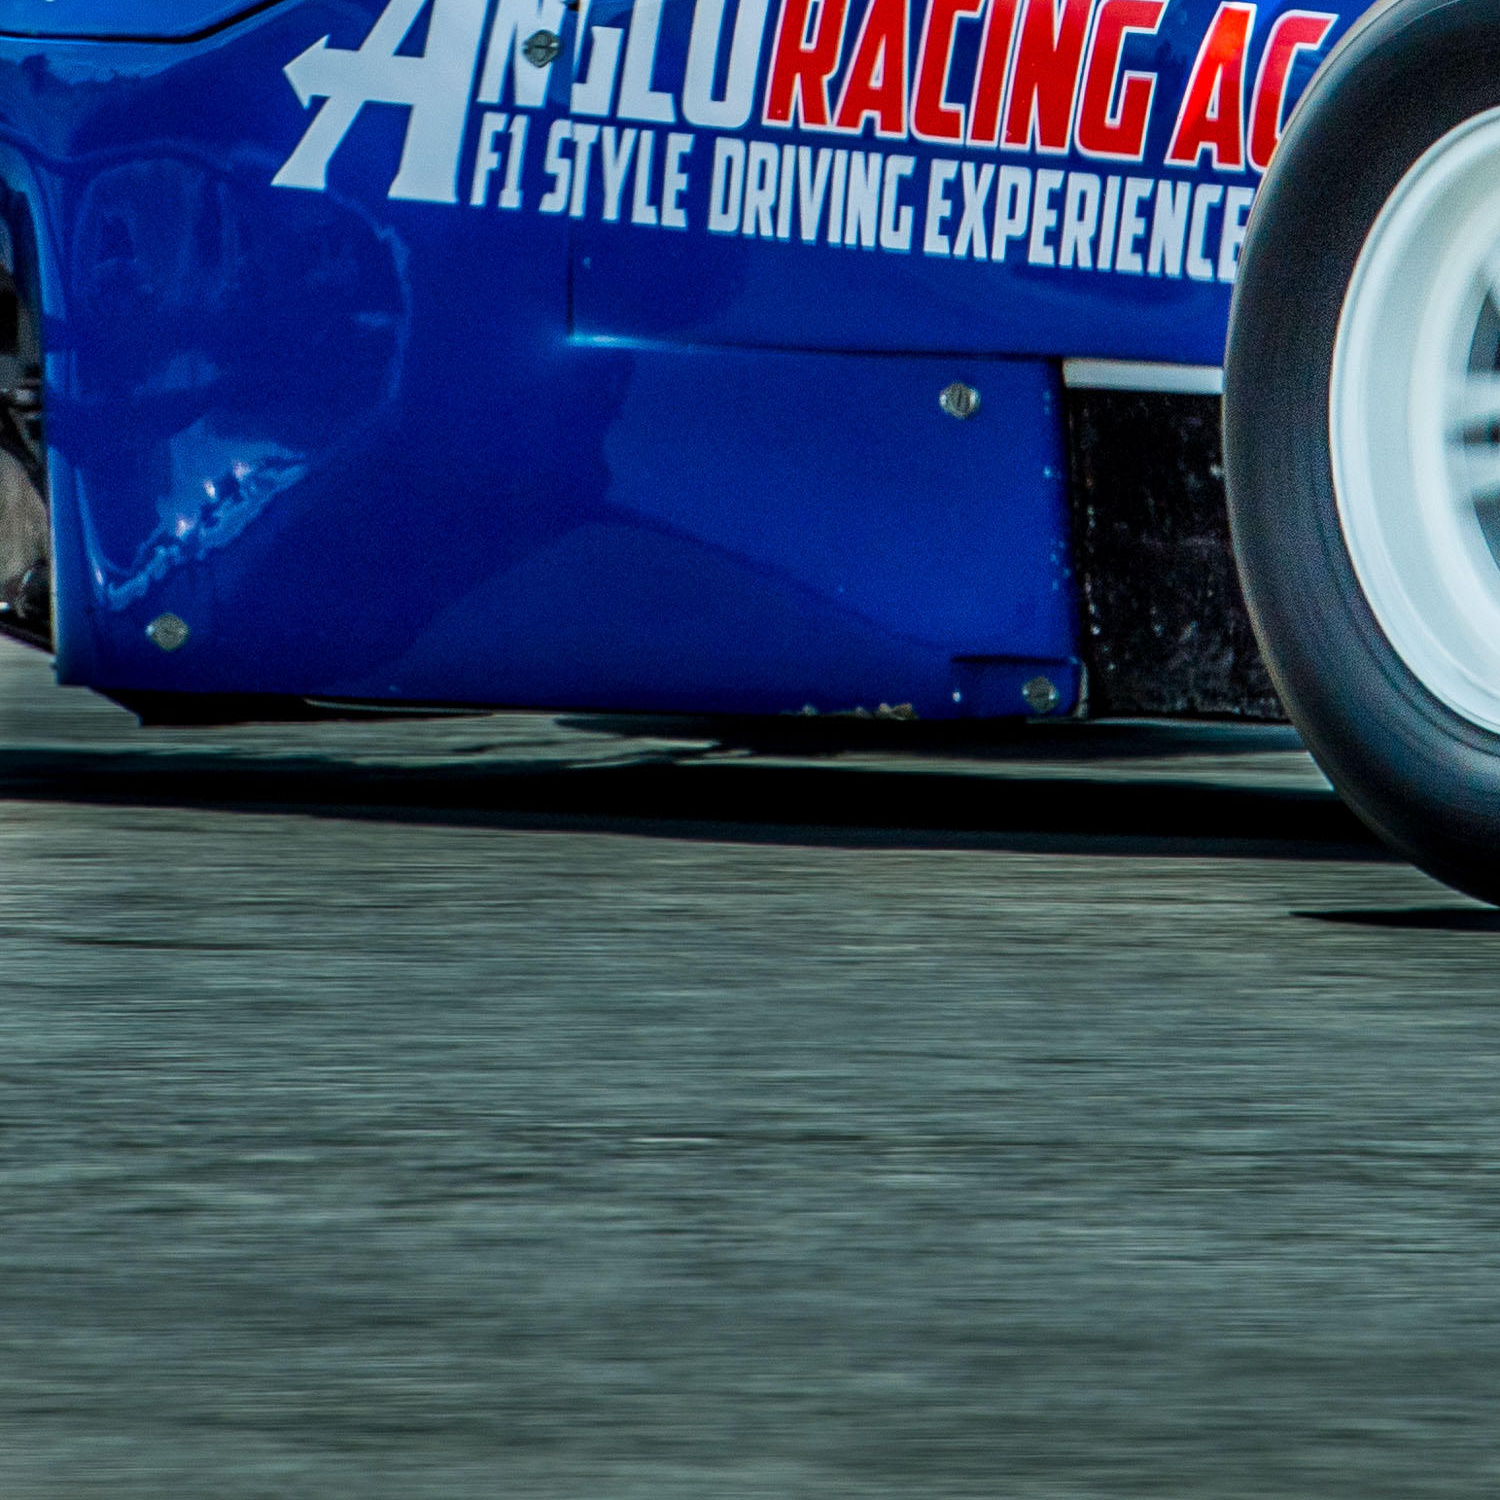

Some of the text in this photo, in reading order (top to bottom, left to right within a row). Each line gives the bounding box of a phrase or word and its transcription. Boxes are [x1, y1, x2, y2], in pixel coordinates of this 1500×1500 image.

[469, 111, 530, 210] F1
[539, 118, 696, 228] STYLE
[708, 136, 915, 252] DRIVING
